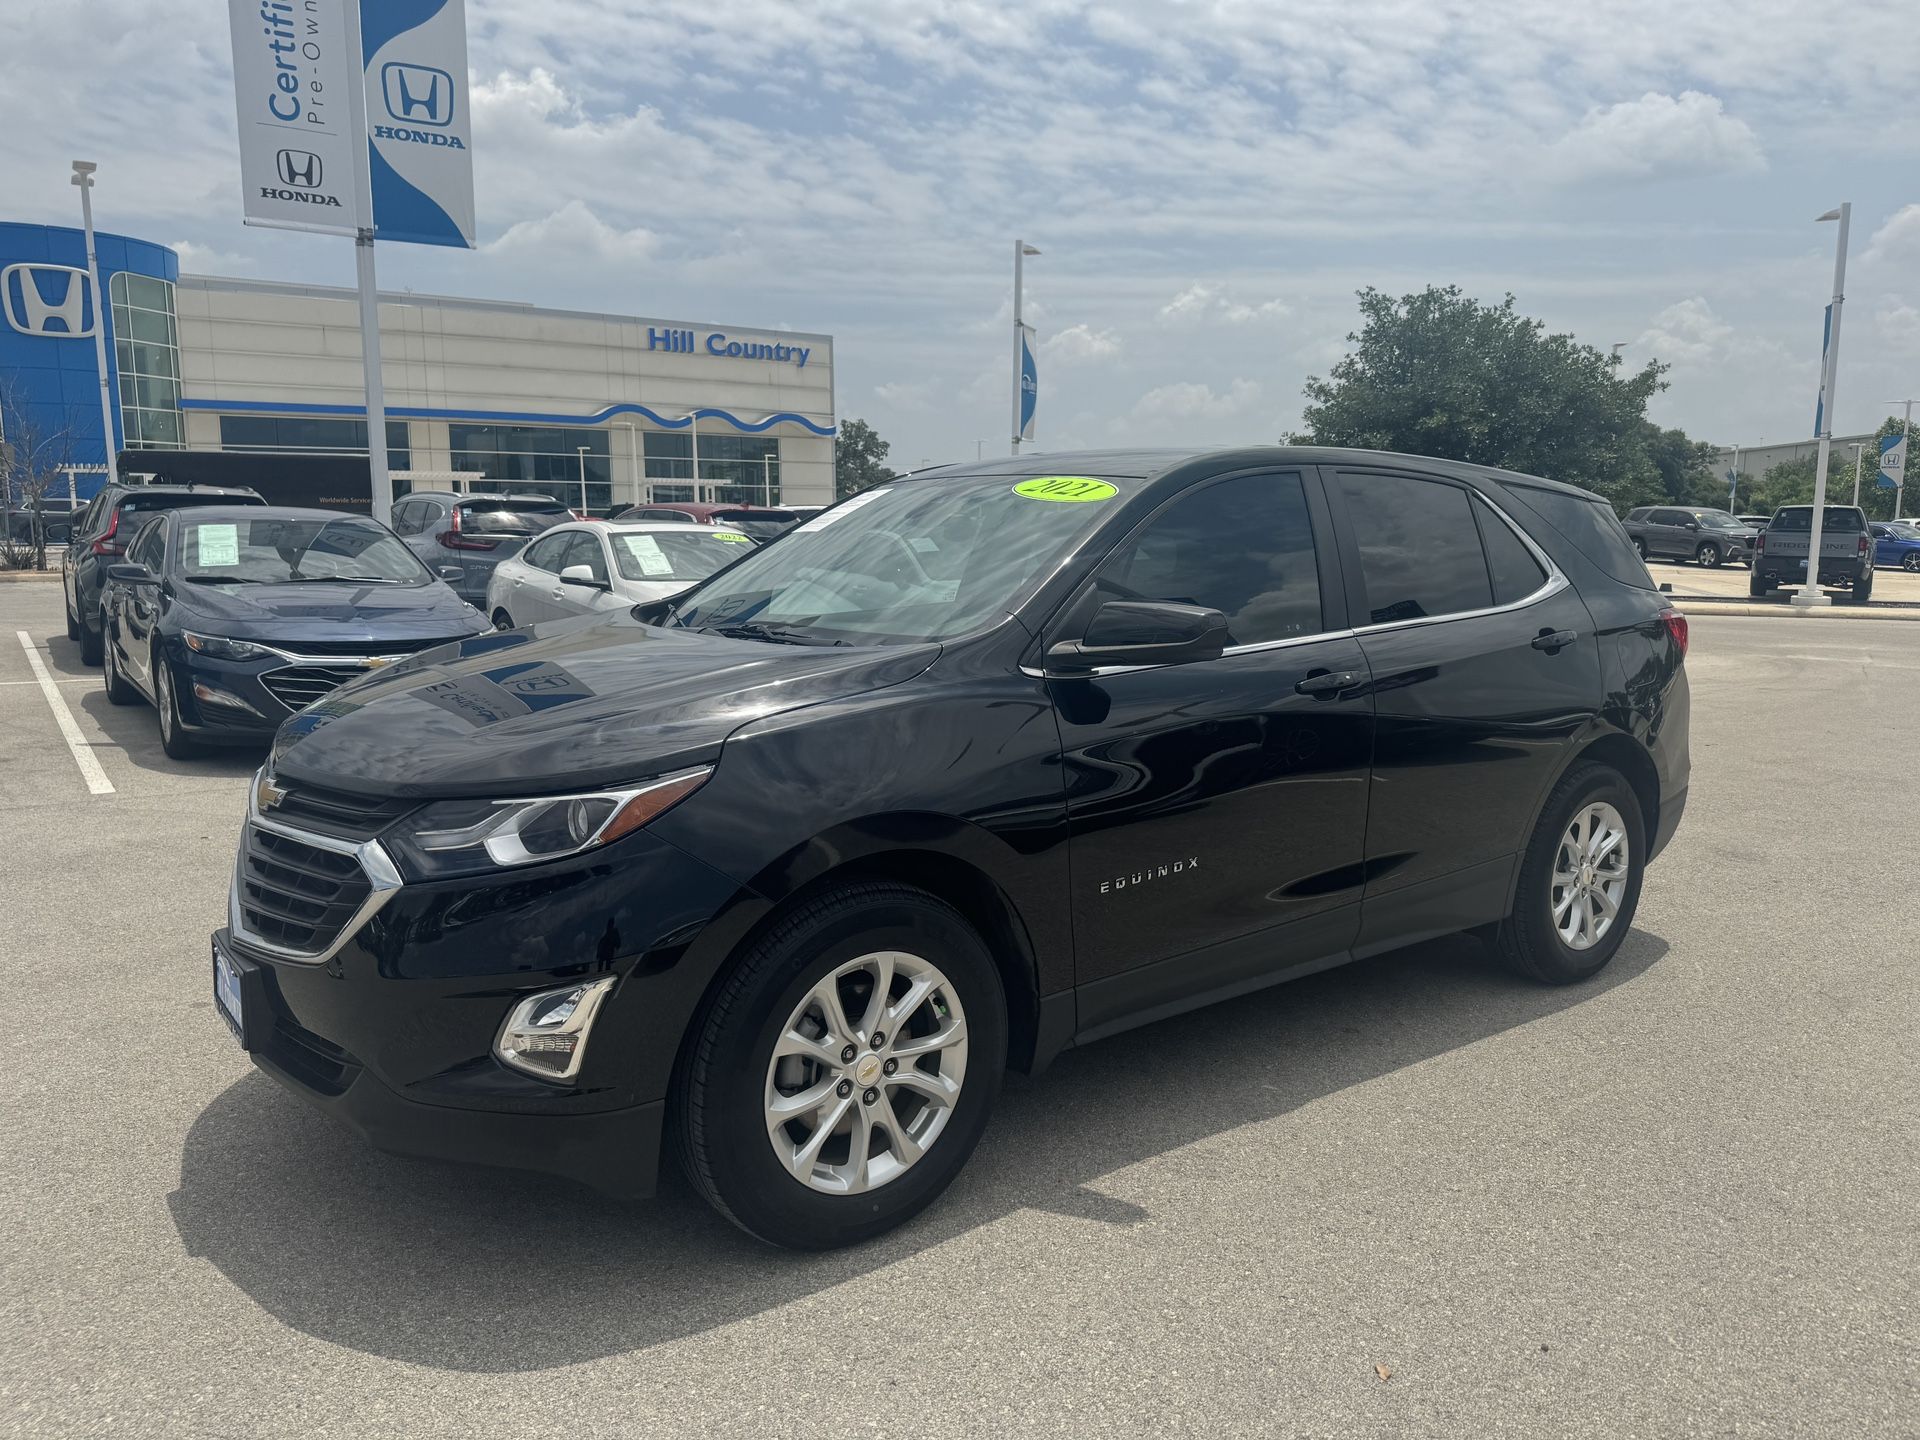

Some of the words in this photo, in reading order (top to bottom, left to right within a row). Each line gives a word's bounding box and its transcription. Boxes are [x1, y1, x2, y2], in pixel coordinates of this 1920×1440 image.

[374, 125, 466, 150] HONDA
[260, 187, 343, 207] HONDA
[648, 327, 695, 354] Hill
[706, 333, 811, 368] Country
[1022, 479, 1107, 497] 2021
[1772, 542, 1850, 551] RIDGINE
[1100, 856, 1199, 894] EQUINOX
